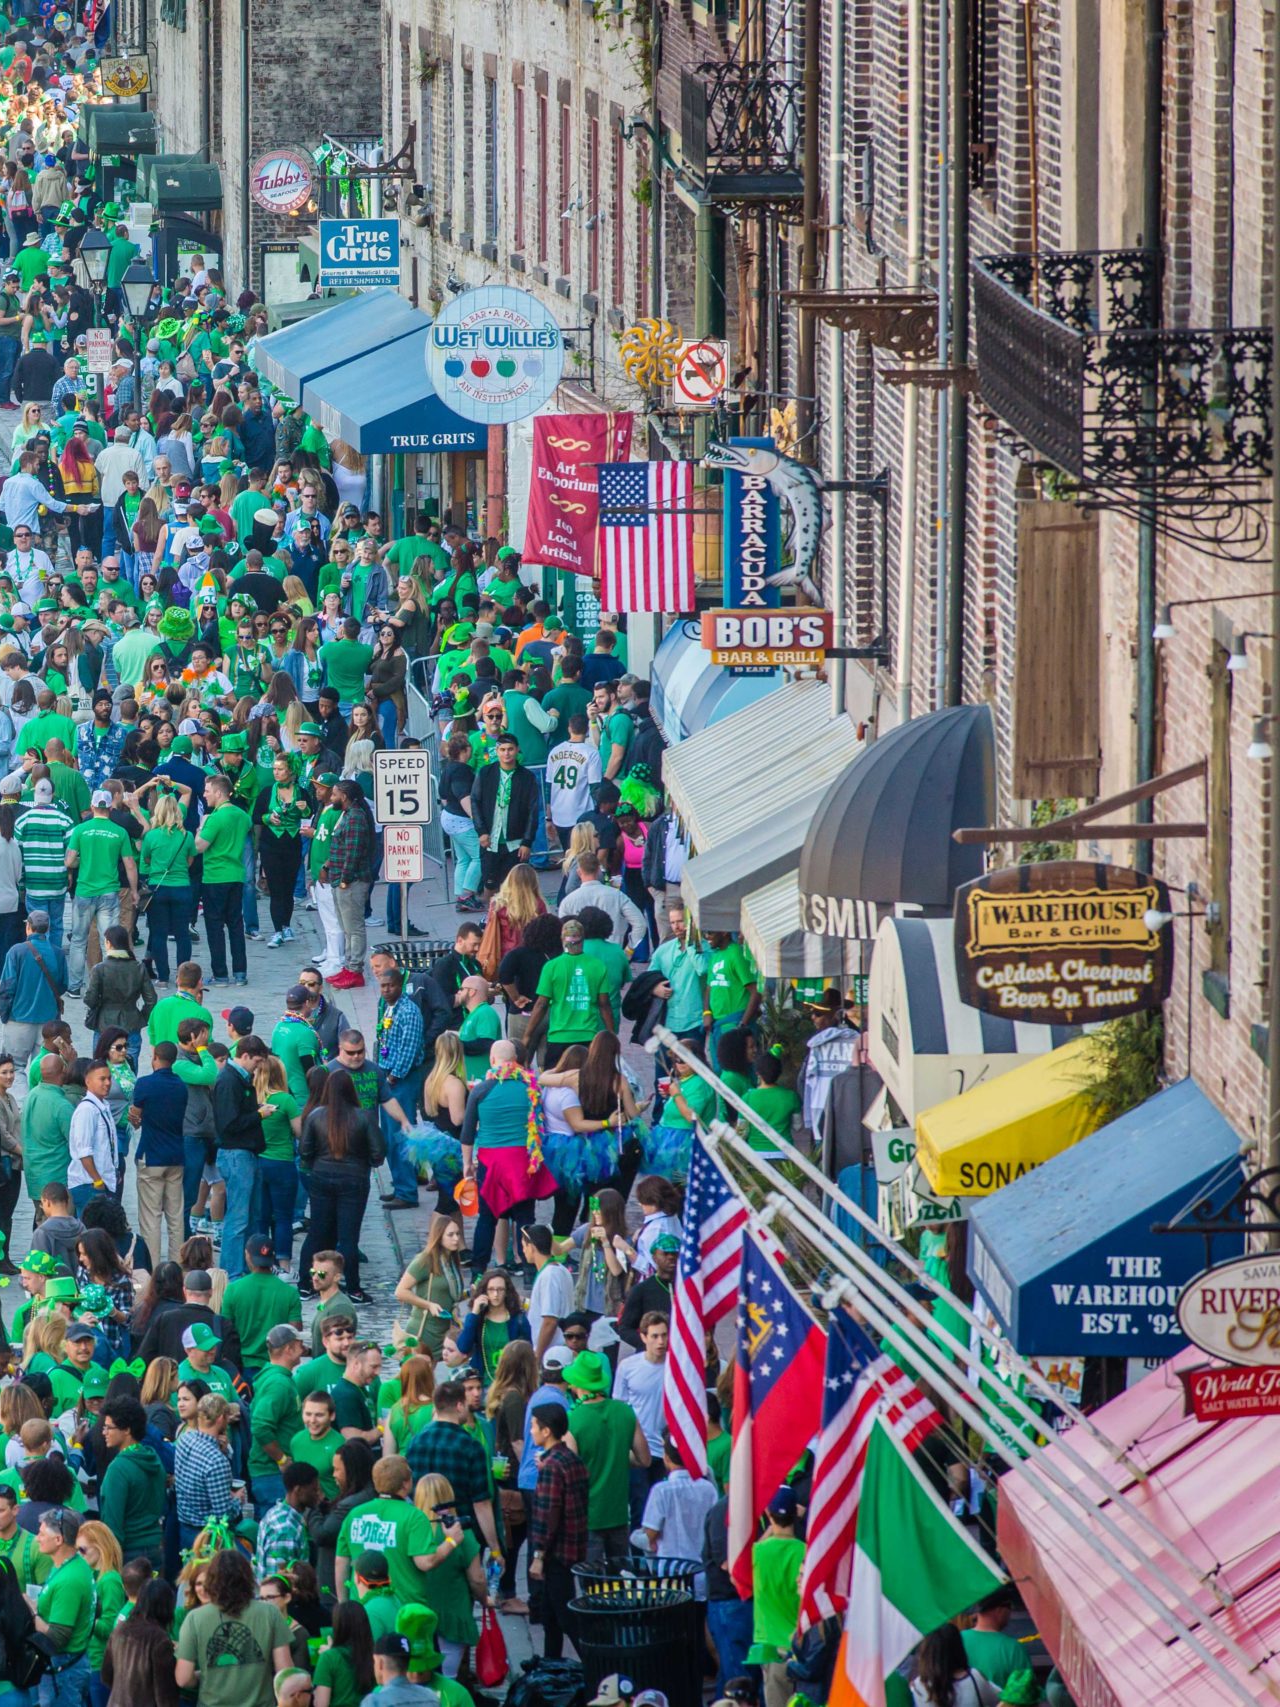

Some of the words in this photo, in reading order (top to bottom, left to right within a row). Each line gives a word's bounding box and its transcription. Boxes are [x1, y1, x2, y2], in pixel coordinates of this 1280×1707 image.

[254, 160, 310, 191] Tubby's
[256, 193, 277, 210] RIVER
[281, 191, 308, 211] STREET
[270, 188, 299, 198] SEAFOOD
[341, 225, 390, 247] True
[326, 235, 392, 262] Grits
[328, 277, 392, 285] REFRESHMENTS
[461, 321, 469, 329] A
[470, 310, 487, 323] BAR
[492, 309, 501, 317] A
[503, 310, 531, 329] PARTY
[459, 381, 472, 393] AN
[473, 382, 529, 403] INSTITUTION
[391, 434, 430, 447] TRUE
[432, 432, 475, 445] GRITS
[556, 462, 576, 476] Art
[548, 531, 577, 550] Local
[740, 475, 767, 606] BARRACUDA
[715, 616, 825, 648] BOB'S
[717, 651, 753, 663] BAR
[755, 651, 770, 663] &
[772, 651, 819, 663] GRILL
[379, 759, 425, 769] SPEED
[550, 750, 587, 765] ANDERSON
[384, 774, 420, 785] LIMIT
[553, 765, 578, 790] 49
[386, 789, 420, 815] 15
[396, 831, 410, 842] NO
[388, 845, 419, 856] PARKING
[397, 869, 411, 877] TIME
[991, 901, 1144, 925] WAREHOUSE
[1008, 928, 1043, 939] Bar
[1049, 926, 1061, 937] &
[1070, 924, 1122, 937] Grille
[976, 961, 1061, 988] Coldest,
[1061, 958, 1154, 986] Cheapest
[997, 986, 1050, 1008] Beer
[1052, 986, 1081, 1008] In
[1082, 985, 1138, 1007] Town
[1106, 1256, 1162, 1278] THE
[1243, 1265, 1280, 1281] SAVA
[1051, 1284, 1182, 1306] WAREHOU
[1081, 1313, 1139, 1334] EST.
[1195, 1372, 1256, 1400] World
[1202, 1401, 1225, 1413] SALT
[1226, 1396, 1260, 1409] WATER
